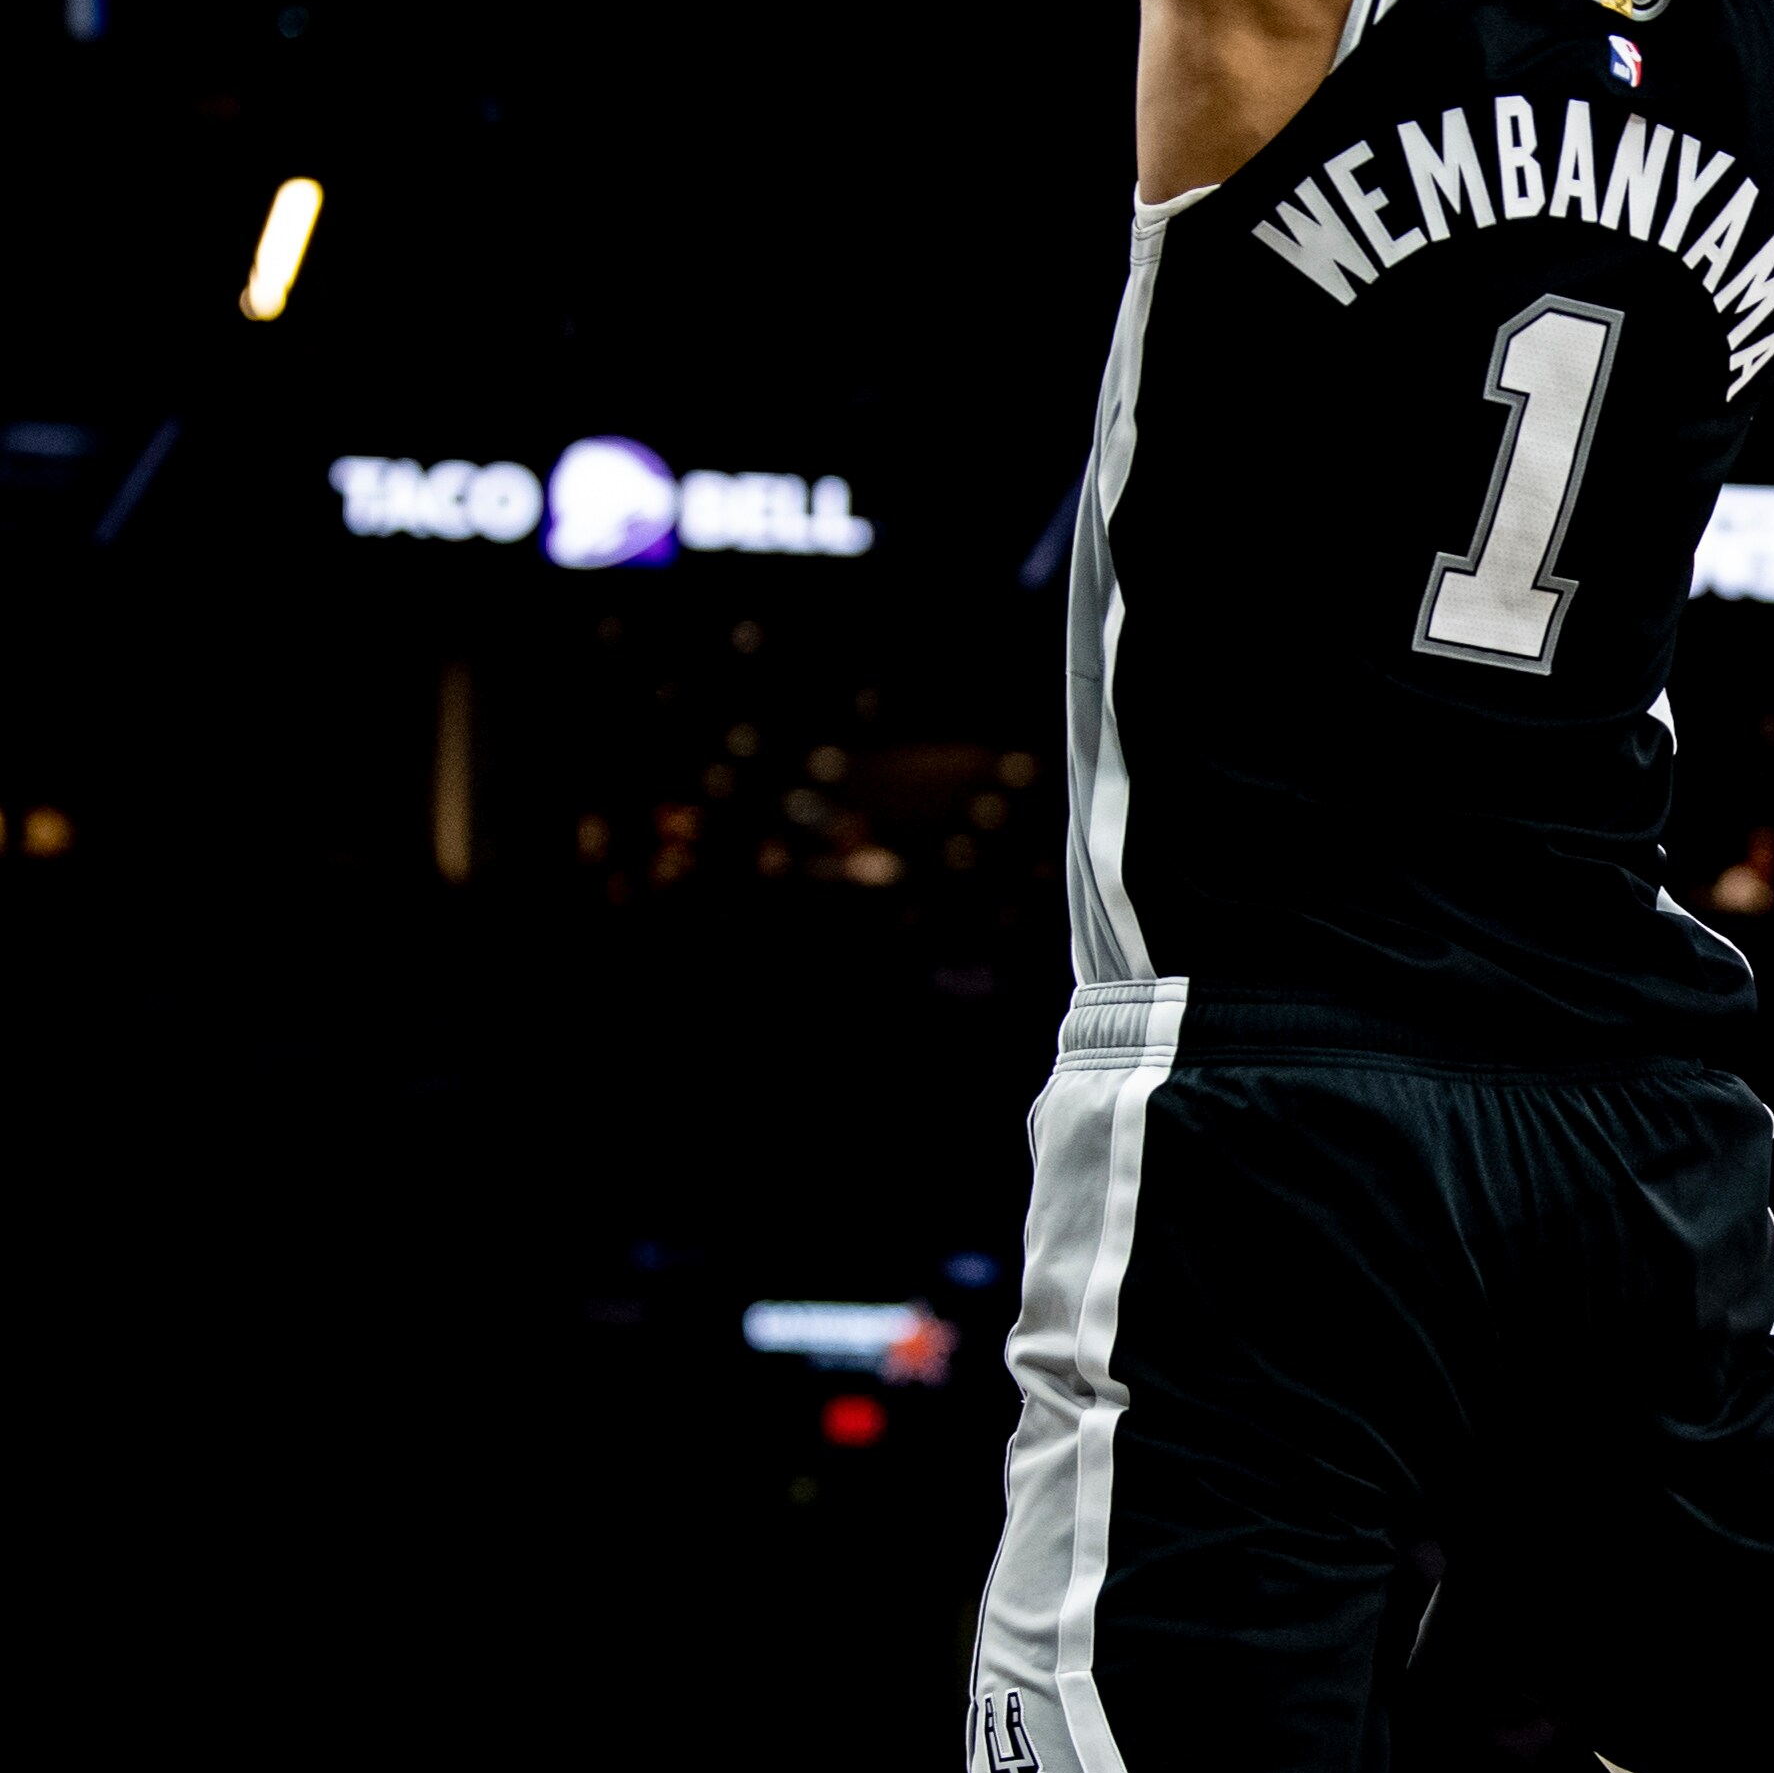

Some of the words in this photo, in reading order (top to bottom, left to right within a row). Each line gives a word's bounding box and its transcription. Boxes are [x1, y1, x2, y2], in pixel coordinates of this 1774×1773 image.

[331, 456, 543, 542] TACO
[679, 469, 874, 556] BELL
[1411, 293, 1625, 676] 1
